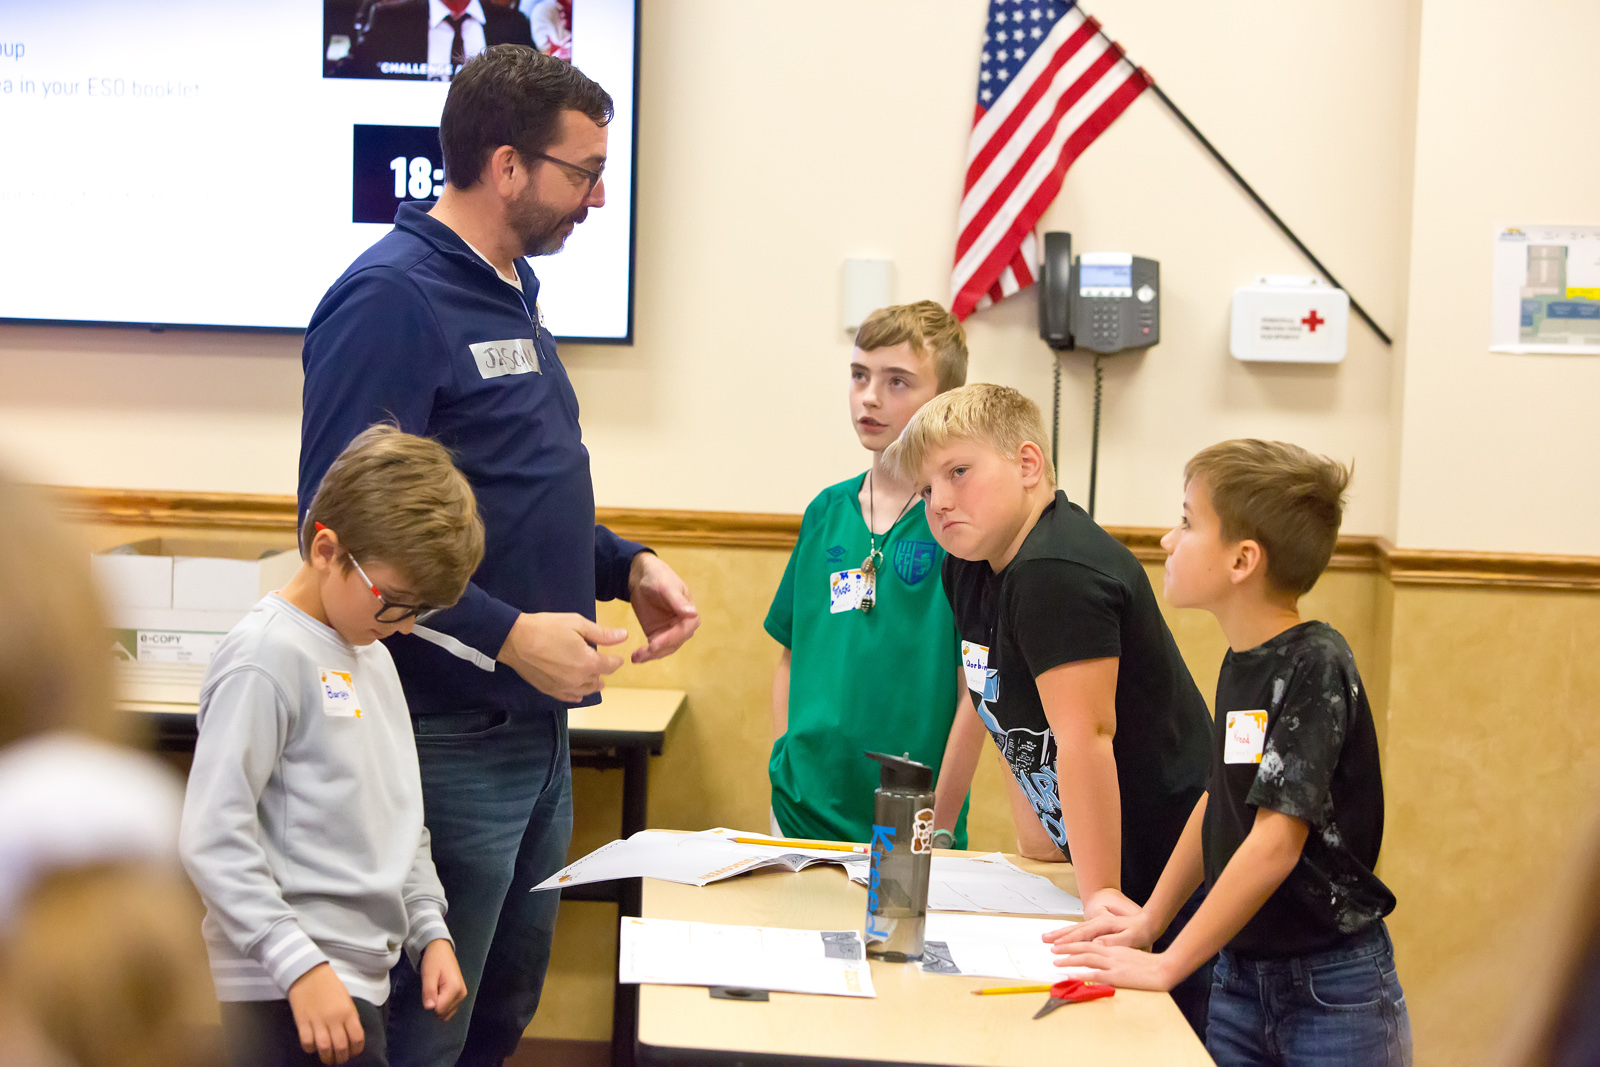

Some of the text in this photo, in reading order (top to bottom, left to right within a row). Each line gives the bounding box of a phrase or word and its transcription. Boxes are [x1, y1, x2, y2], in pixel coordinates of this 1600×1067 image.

[0, 42, 25, 61] up
[0, 79, 13, 94] a
[20, 75, 35, 94] in
[42, 81, 80, 99] your
[132, 79, 199, 98] booklet
[865, 825, 896, 937] Kreed
